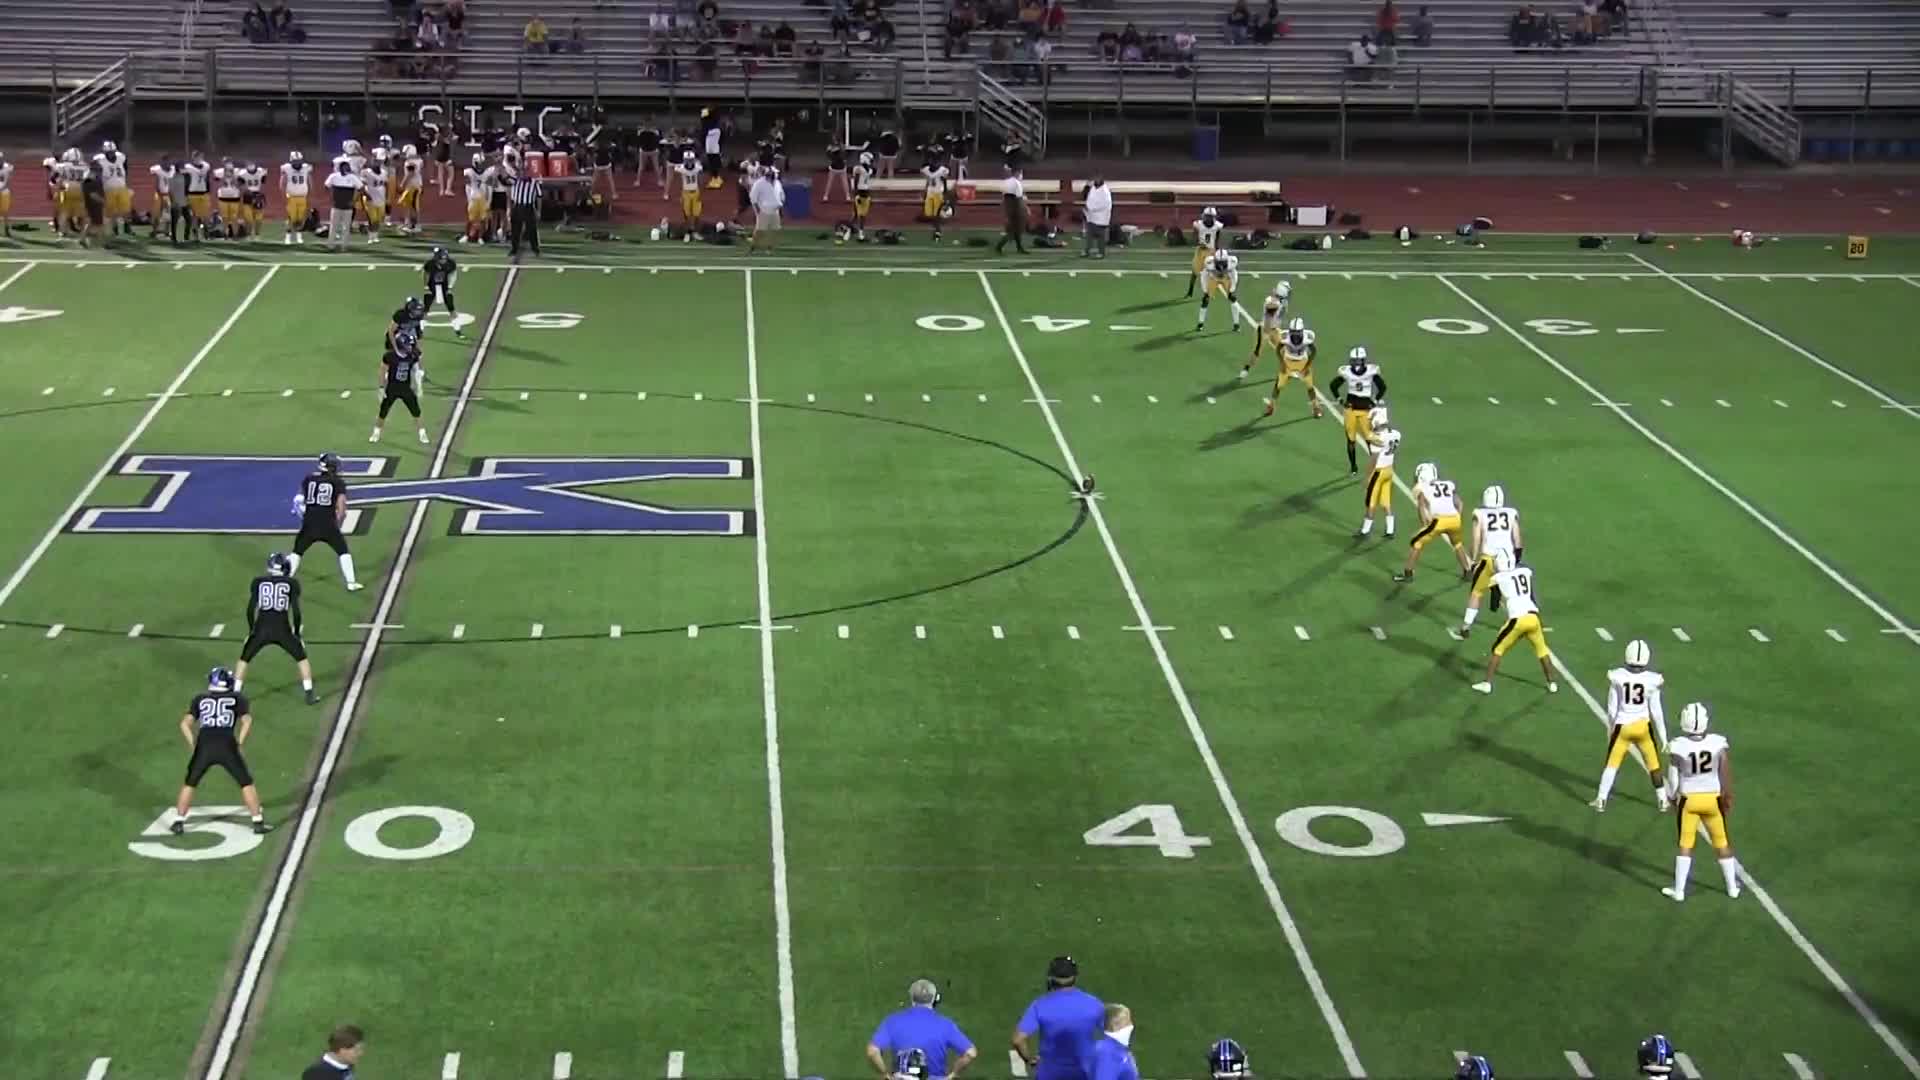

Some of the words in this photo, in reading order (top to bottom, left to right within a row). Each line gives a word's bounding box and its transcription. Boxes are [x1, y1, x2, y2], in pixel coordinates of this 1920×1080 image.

[306, 481, 333, 506] 12
[1430, 482, 1451, 498] 32
[1487, 513, 1509, 531] 23
[258, 581, 290, 611] 86
[1511, 574, 1529, 596] 19
[1623, 682, 1645, 705] 13
[199, 697, 236, 728] 25
[1688, 751, 1713, 774] 12
